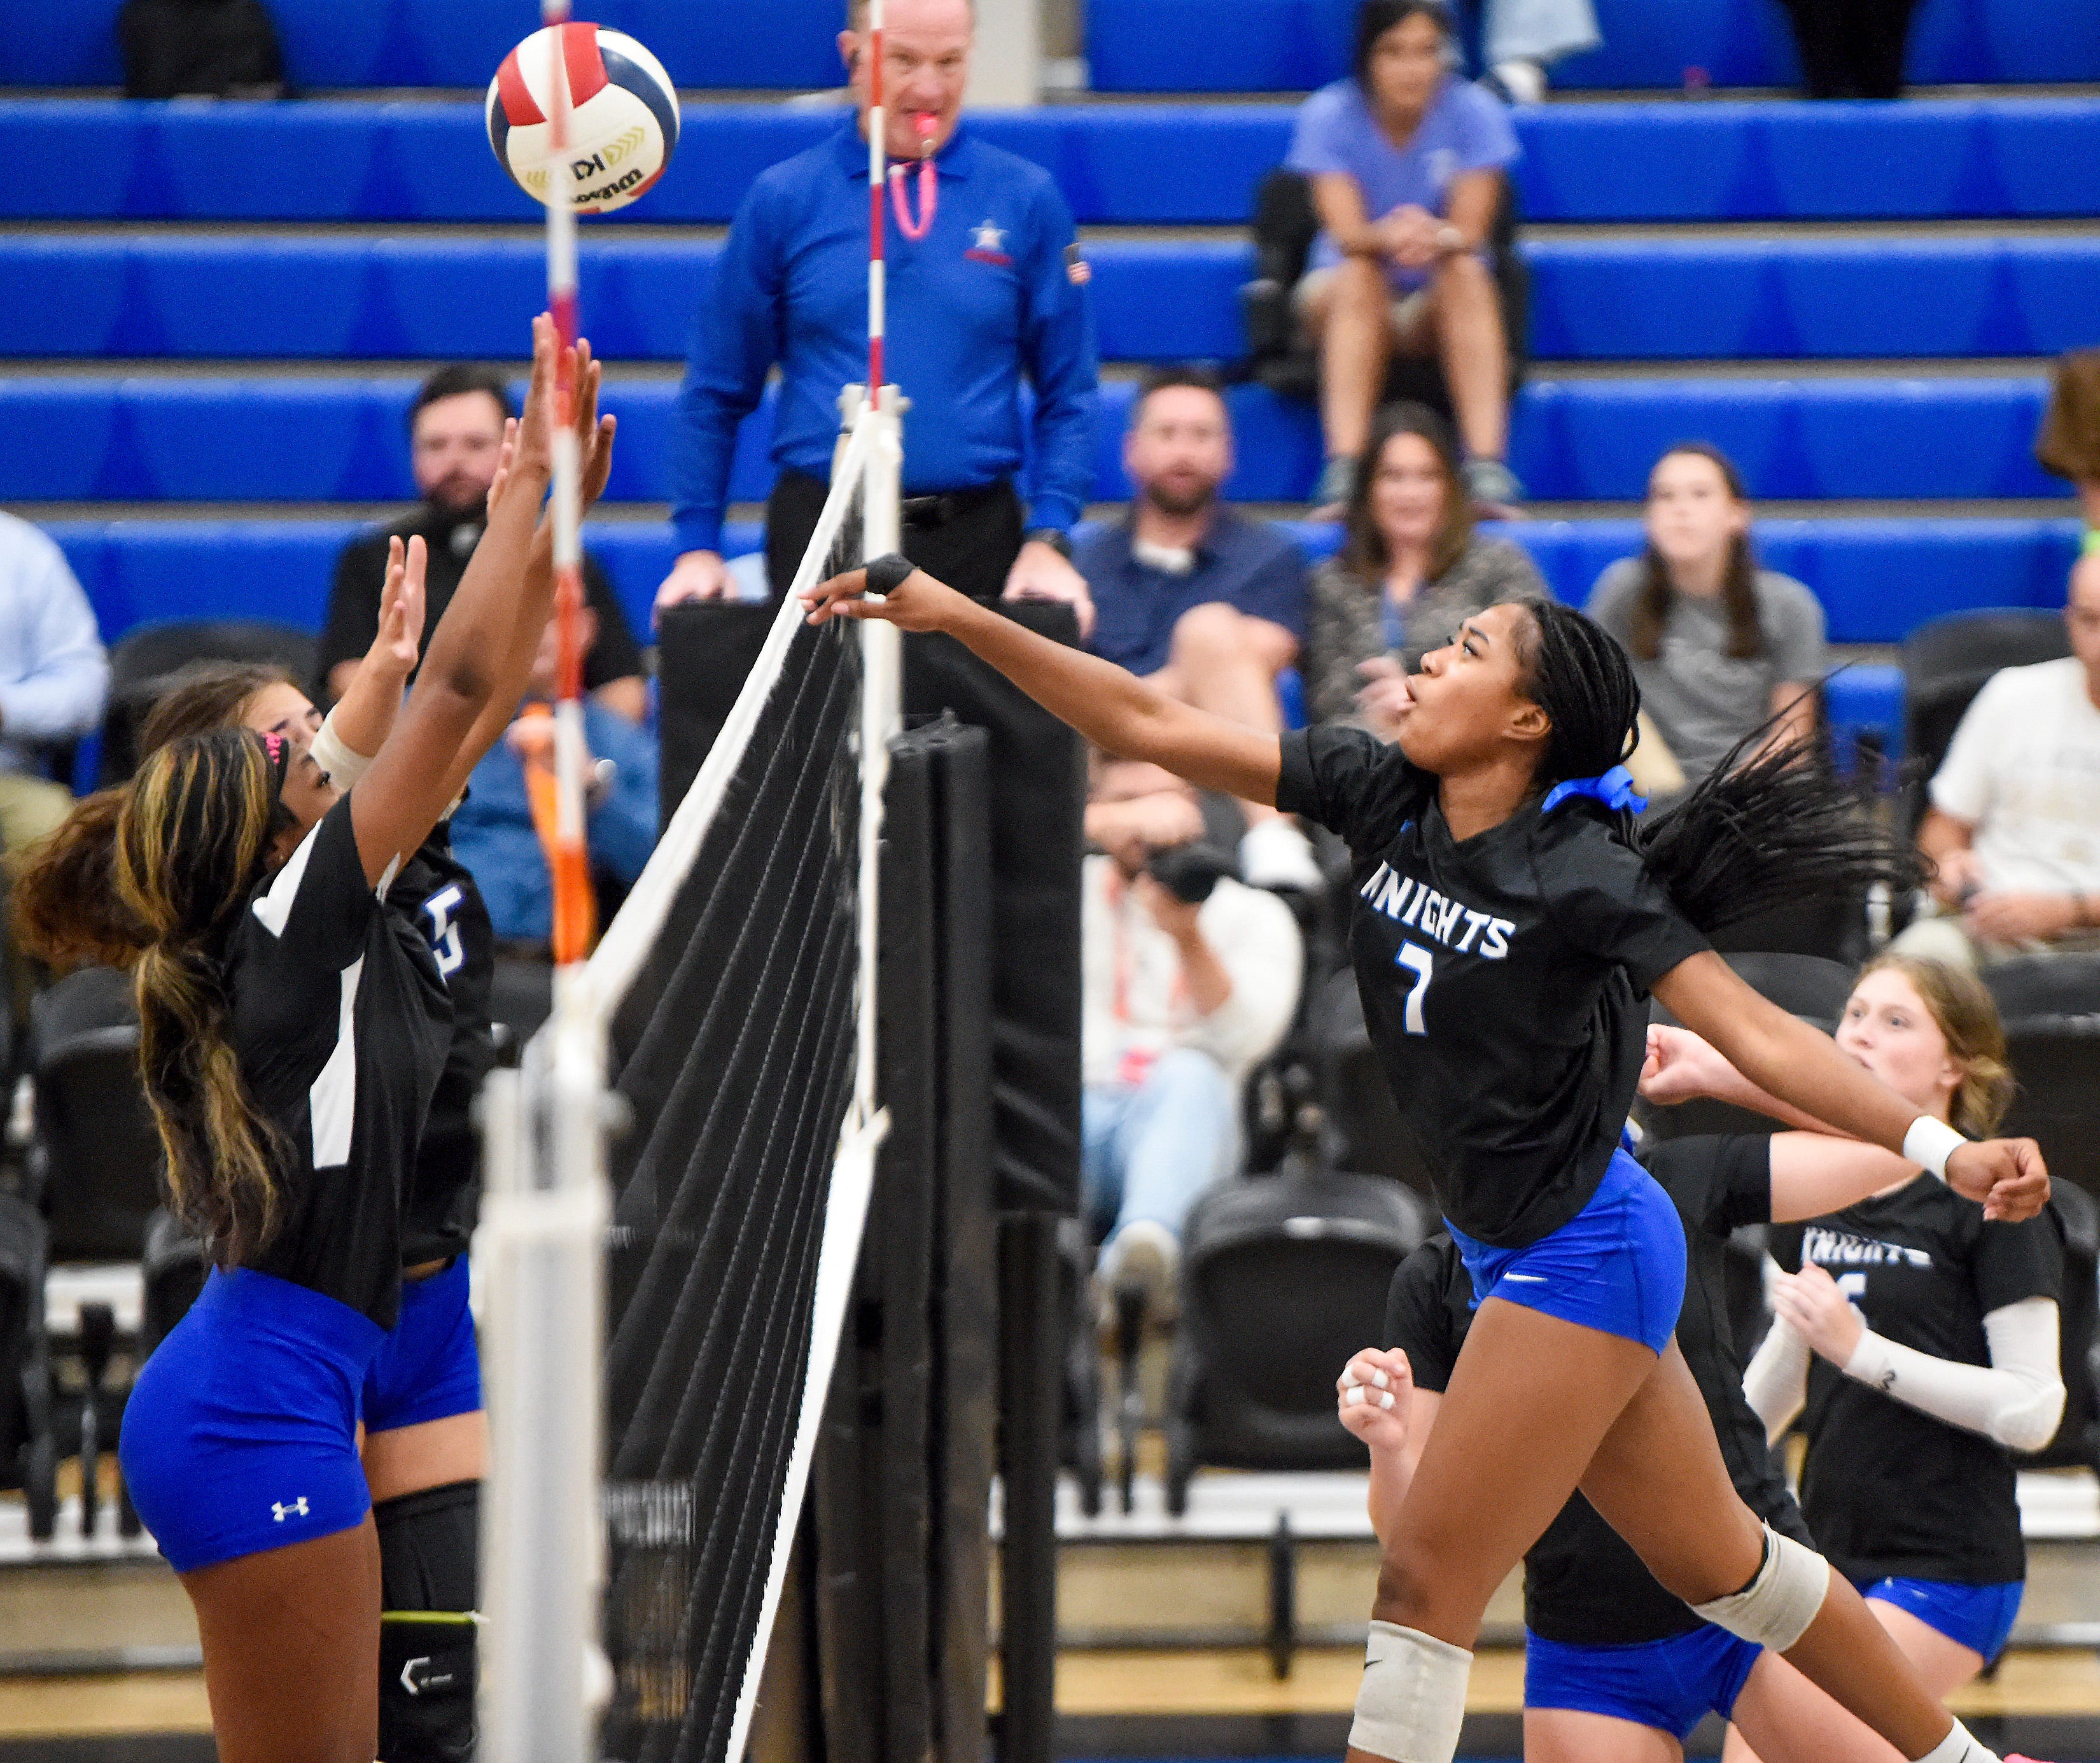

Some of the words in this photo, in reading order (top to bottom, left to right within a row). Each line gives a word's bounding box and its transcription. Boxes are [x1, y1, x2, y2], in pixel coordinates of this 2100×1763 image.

[570, 167, 644, 204] Wilso
[421, 882, 467, 985] 5
[1394, 938, 1434, 1036] 7
